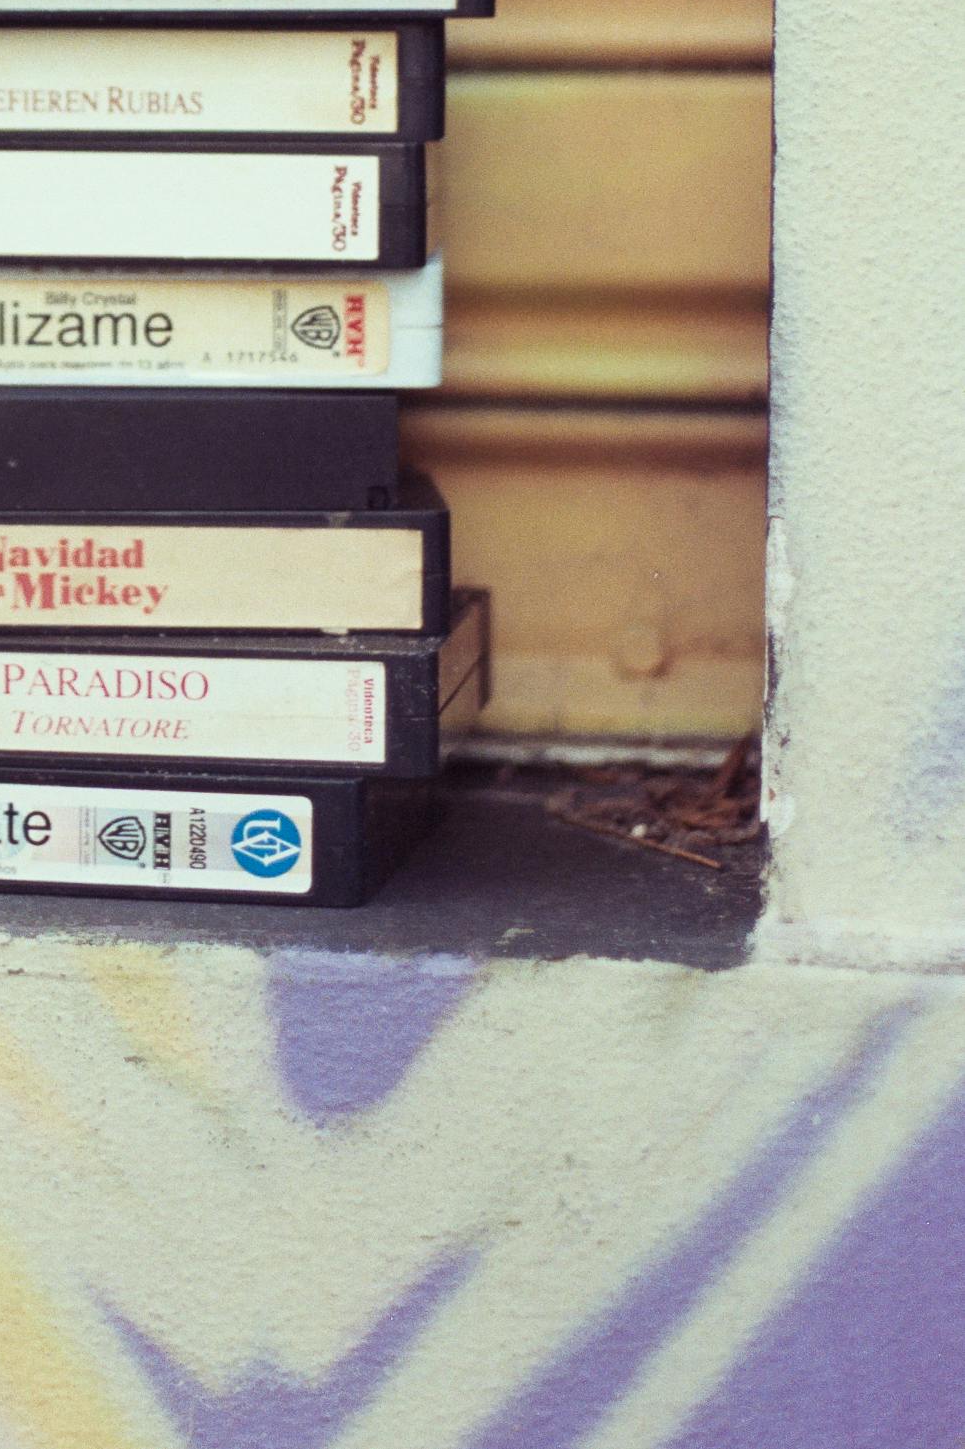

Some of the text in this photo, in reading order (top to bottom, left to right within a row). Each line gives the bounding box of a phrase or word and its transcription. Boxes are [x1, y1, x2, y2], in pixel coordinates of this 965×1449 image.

[106, 86, 204, 115] RUBIAS
[82, 291, 137, 306] Crystal
[10, 572, 169, 614] Mickey
[2, 664, 210, 701] PARADISO
[11, 710, 190, 740] TORNATORE
[364, 678, 374, 744] Videoteca
